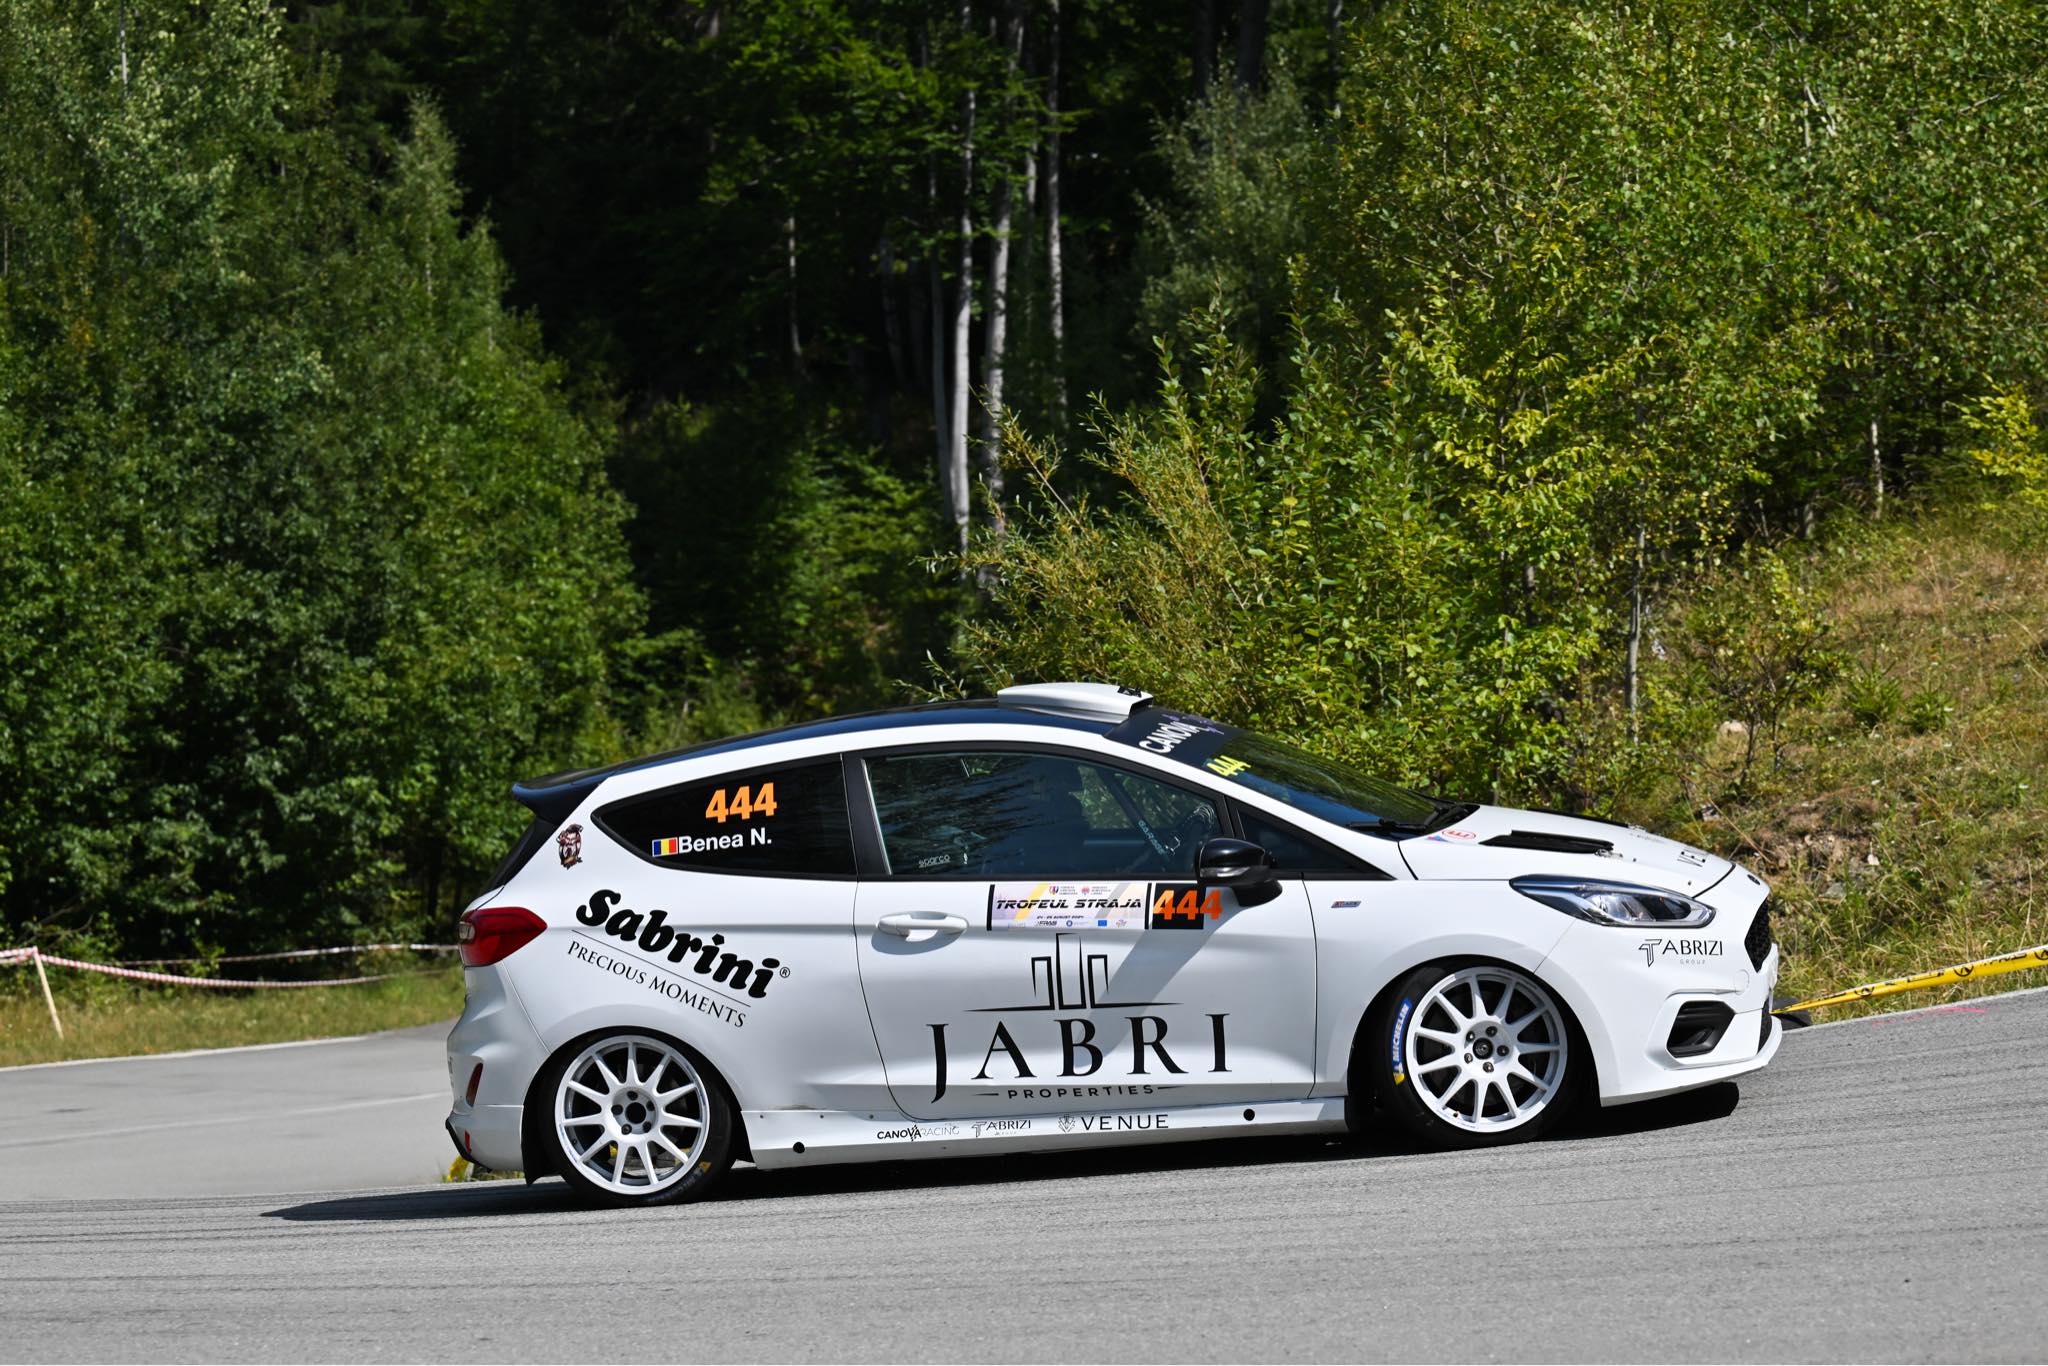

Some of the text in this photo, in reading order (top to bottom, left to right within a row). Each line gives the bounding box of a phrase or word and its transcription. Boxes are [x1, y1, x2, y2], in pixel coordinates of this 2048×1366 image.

[1206, 755, 1252, 777] 444
[705, 782, 778, 823] 444
[678, 827, 773, 854] Benea N.
[996, 898, 1142, 909] TROFEUL STRAJA
[1153, 889, 1223, 920] 444
[567, 940, 746, 1028] PRECIOUS MOMENTS
[1392, 1003, 1409, 1061] MICHELIN
[926, 1012, 1233, 1104] JABRI
[1007, 1084, 1154, 1099] PROPERTIES
[1081, 1113, 1169, 1131] VENUE
